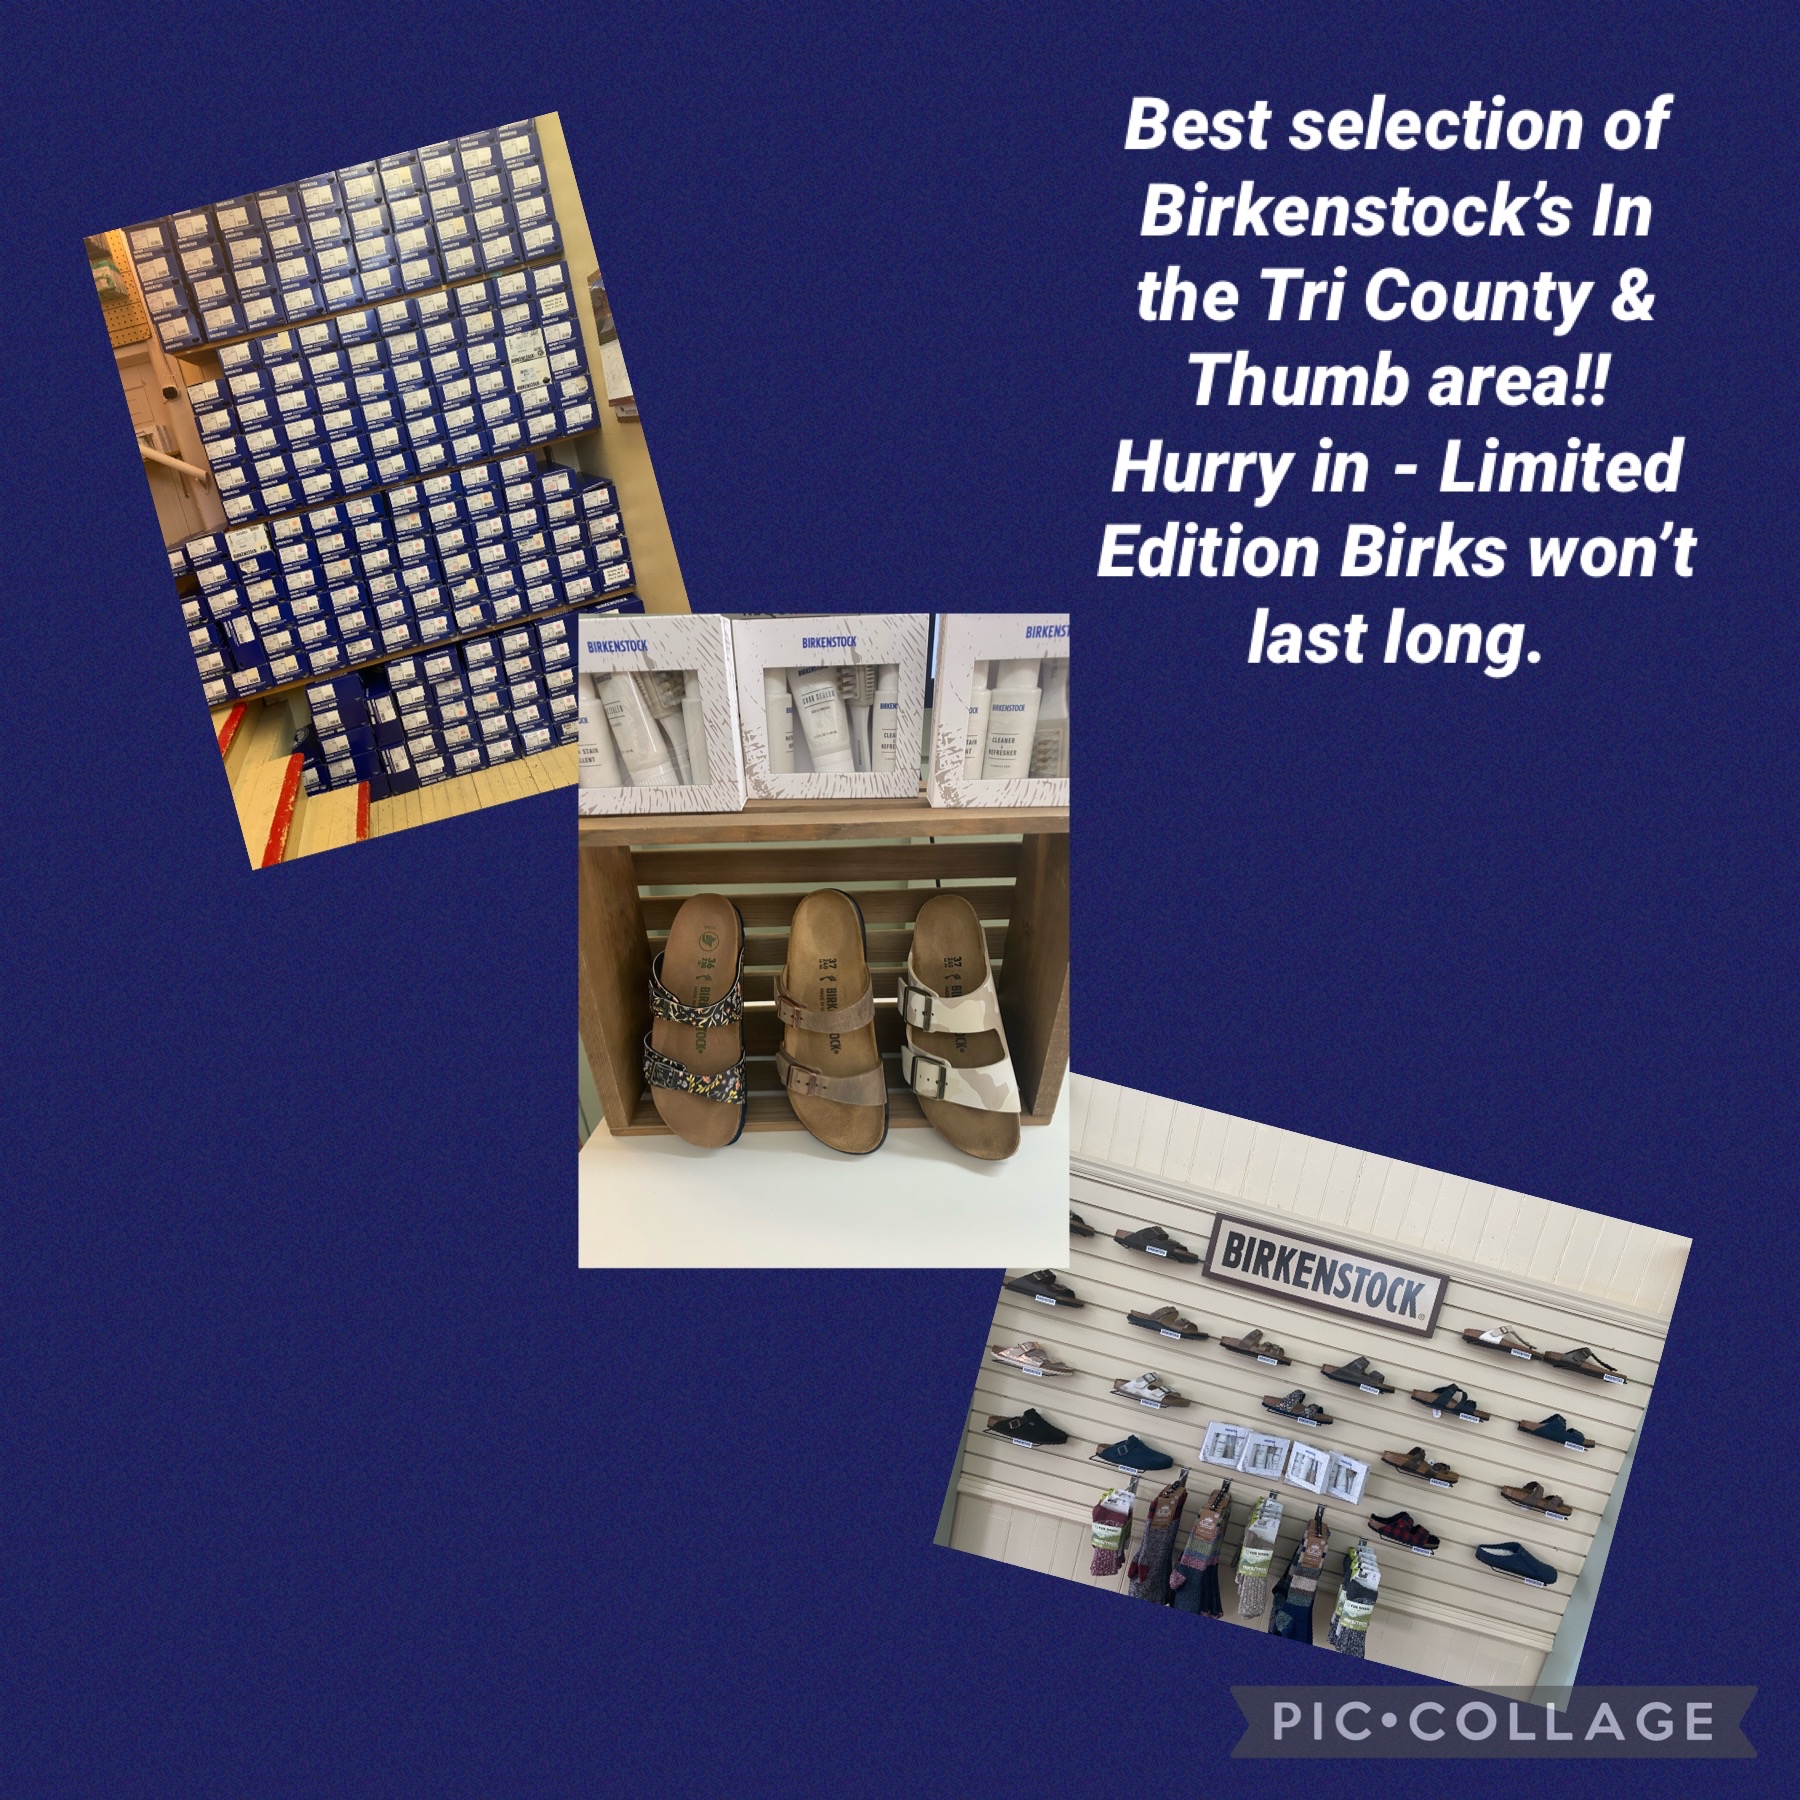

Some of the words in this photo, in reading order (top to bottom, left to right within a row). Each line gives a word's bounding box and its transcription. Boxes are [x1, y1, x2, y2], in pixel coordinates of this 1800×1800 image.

[587, 640, 648, 653] BIRKENSTOCK
[802, 636, 857, 648] BIRKENSTOCK
[992, 703, 1025, 712] BIRKENSTOCK
[988, 748, 1017, 756] REFRESHER
[828, 958, 837, 969] 37
[953, 956, 962, 967] 37
